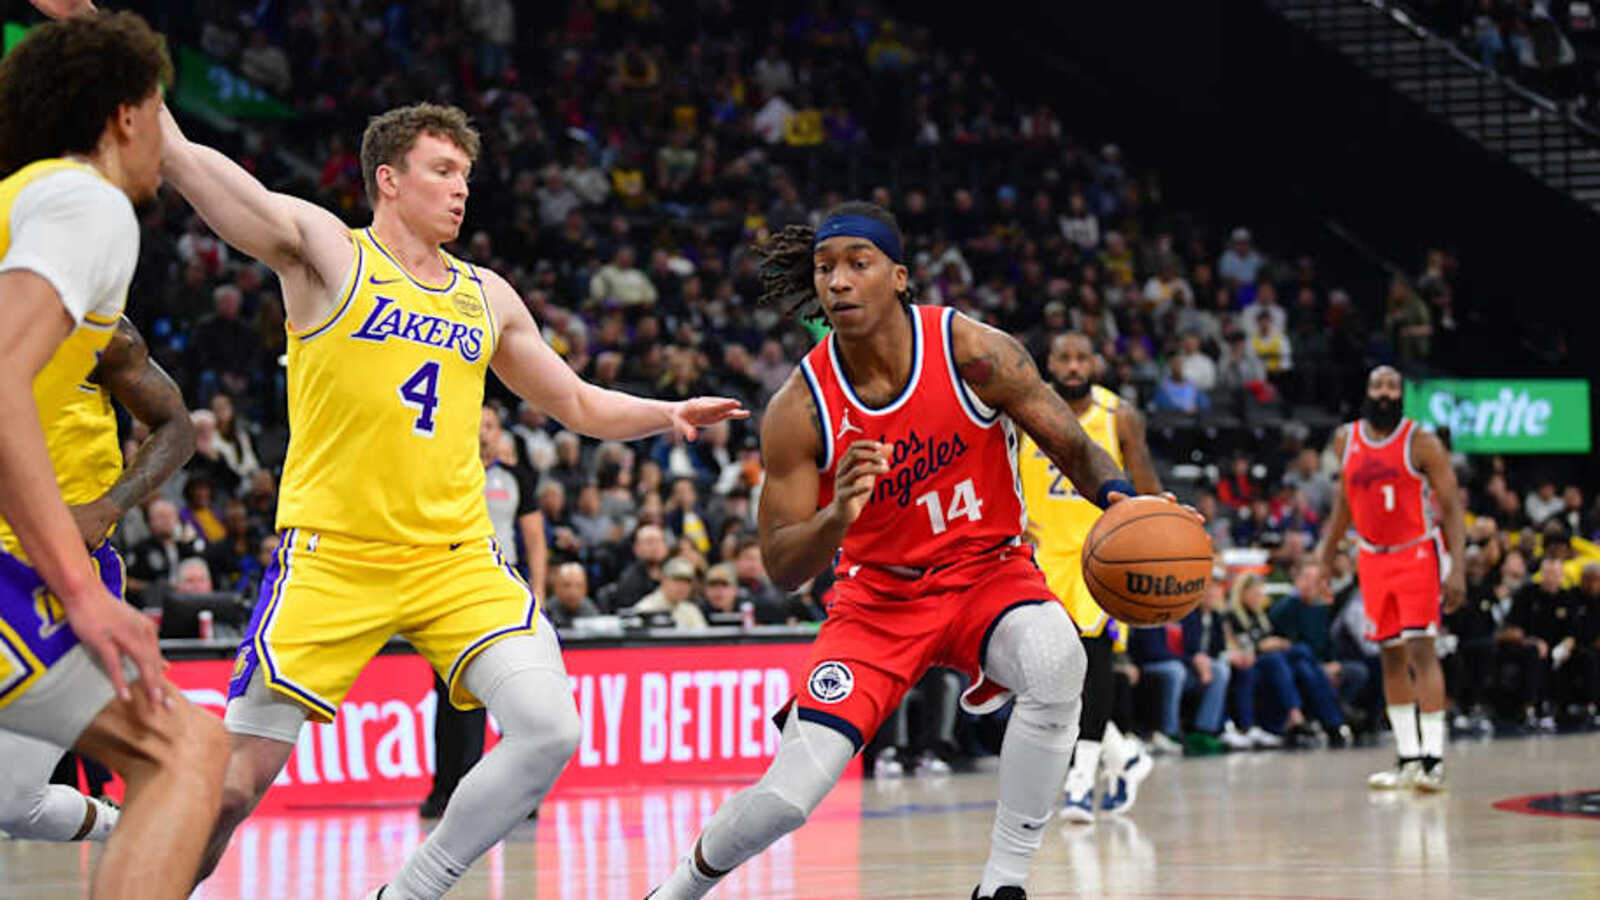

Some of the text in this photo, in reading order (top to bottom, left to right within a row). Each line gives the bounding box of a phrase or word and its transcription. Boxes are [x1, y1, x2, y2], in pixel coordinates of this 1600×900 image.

[350, 295, 484, 362] LAKERS
[399, 360, 440, 437] 4
[915, 477, 984, 535] 14
[1381, 484, 1395, 512] 1
[1125, 571, 1206, 597] Wilson
